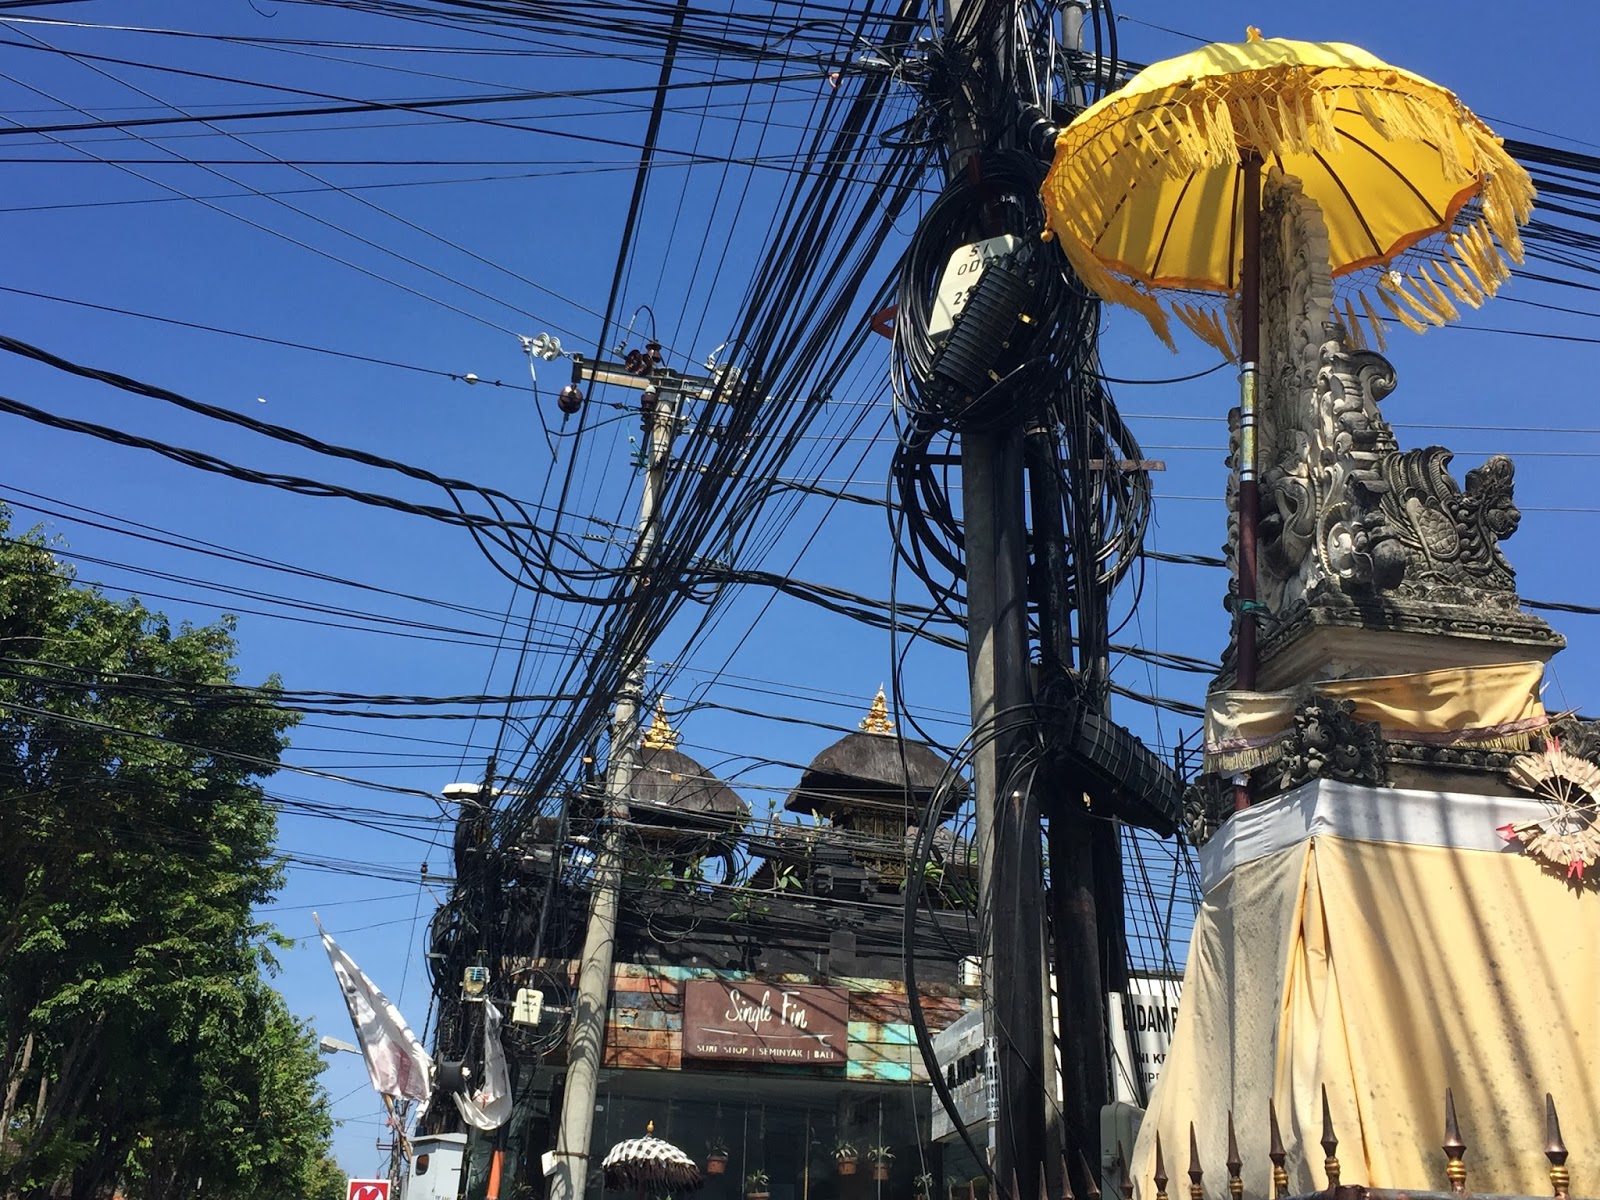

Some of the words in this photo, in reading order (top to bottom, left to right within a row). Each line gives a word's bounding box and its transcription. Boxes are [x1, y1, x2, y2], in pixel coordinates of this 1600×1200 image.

[725, 989, 772, 1031] Single
[781, 990, 809, 1029] Fin
[696, 1044, 718, 1054] SURF
[723, 1046, 749, 1056] SHOP
[758, 1047, 803, 1058] SEMINYAK
[813, 1050, 834, 1060] BALI
